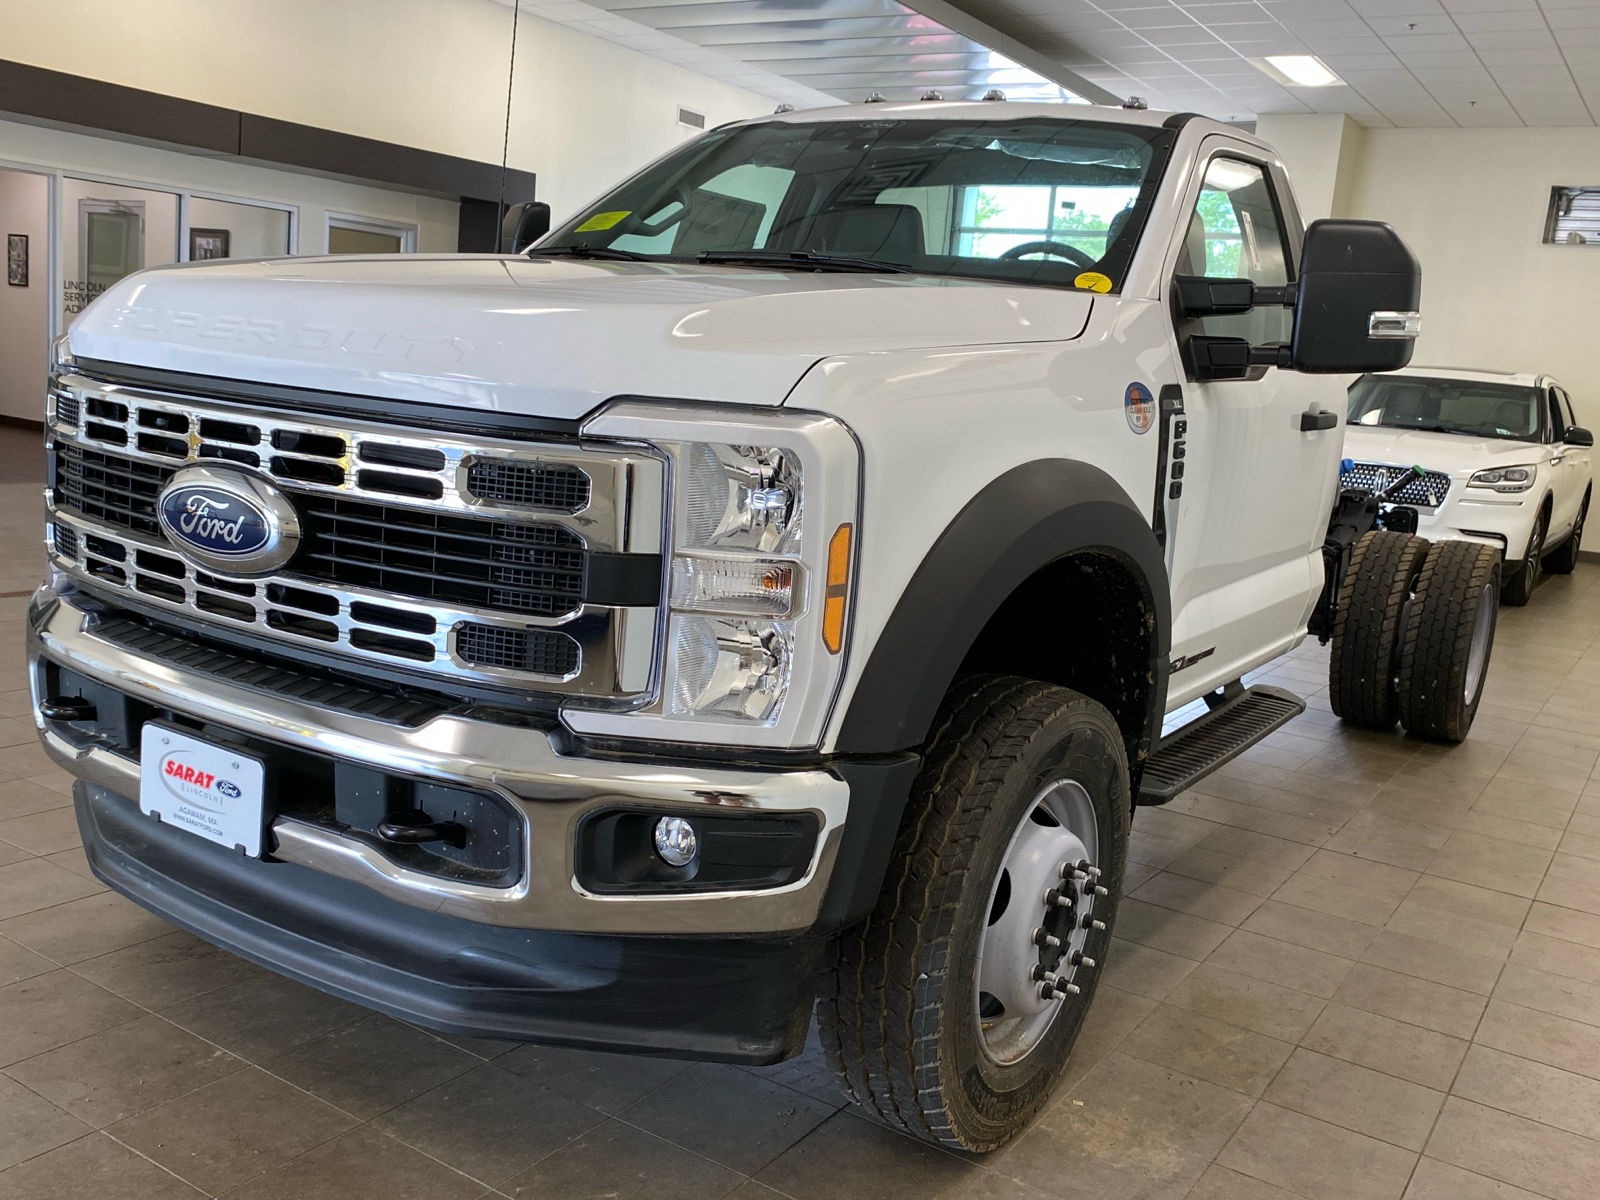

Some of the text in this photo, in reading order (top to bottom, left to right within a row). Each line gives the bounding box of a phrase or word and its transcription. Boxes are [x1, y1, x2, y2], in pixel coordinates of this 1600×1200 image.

[63, 280, 106, 292] LINCOLN
[63, 292, 99, 302] SERVIC
[289, 324, 503, 365] DUTY
[1173, 399, 1182, 408] XL
[180, 495, 245, 544] Ford
[164, 760, 215, 789] SARAT
[186, 786, 218, 803] LINCOLN
[219, 782, 238, 797] Ford
[179, 806, 217, 826] AGAWAM, MA
